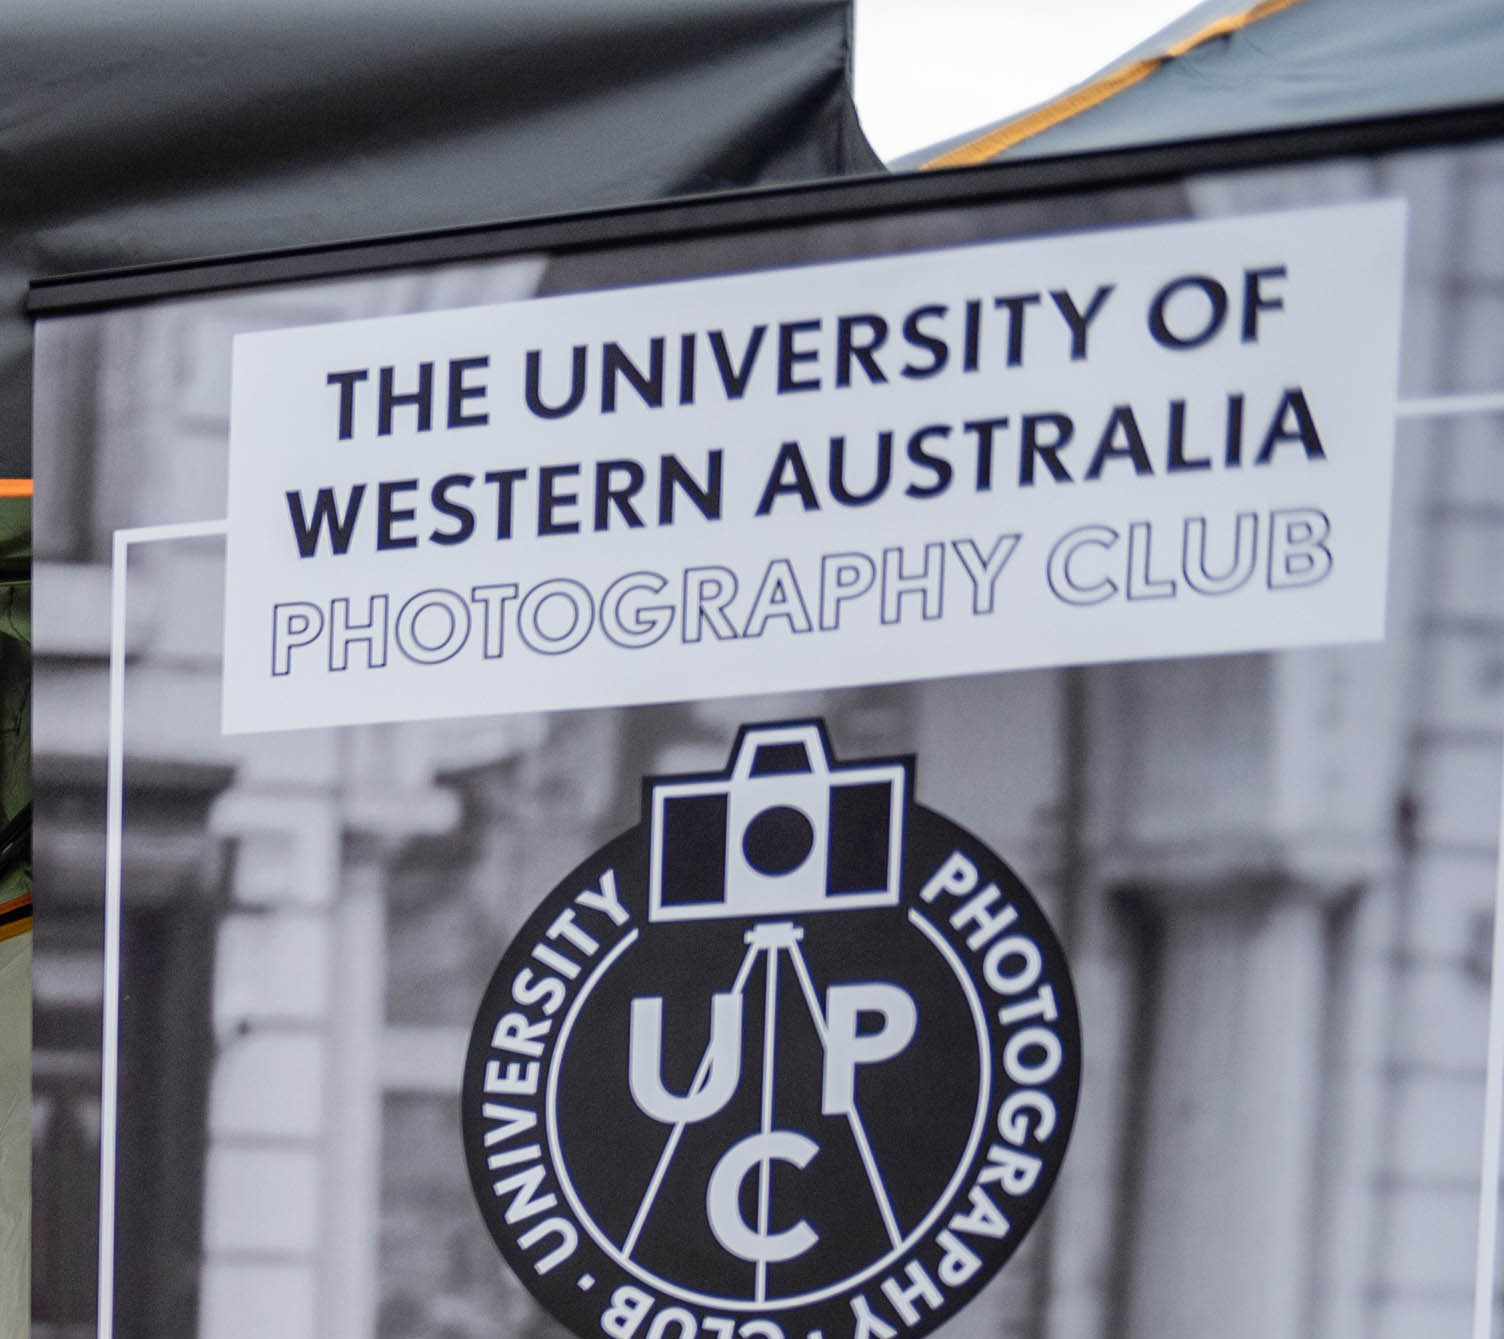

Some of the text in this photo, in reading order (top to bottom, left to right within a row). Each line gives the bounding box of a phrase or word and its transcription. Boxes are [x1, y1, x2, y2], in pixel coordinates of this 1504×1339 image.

[327, 266, 1289, 441] THE UNIVERSITY OF
[285, 385, 1326, 560] WESTERN AUSTRALIA
[270, 507, 1335, 678] PHOTOGRAPHY CLUB
[483, 868, 630, 1276] UNIVERSITY
